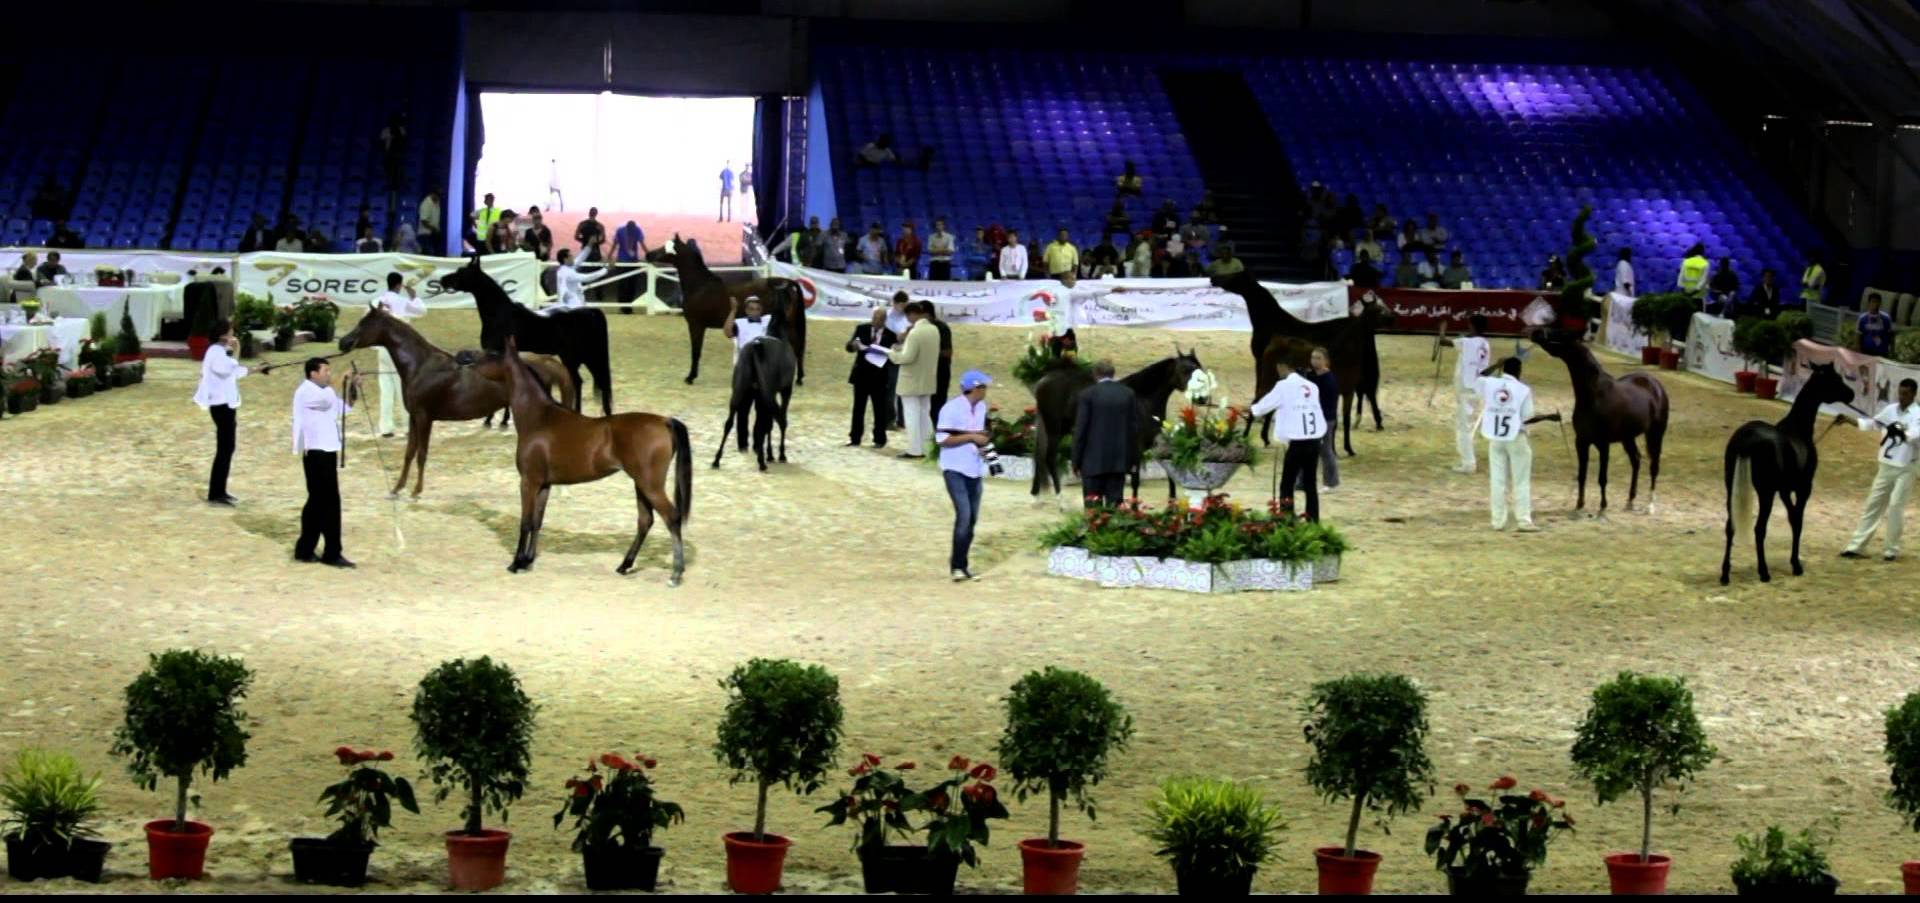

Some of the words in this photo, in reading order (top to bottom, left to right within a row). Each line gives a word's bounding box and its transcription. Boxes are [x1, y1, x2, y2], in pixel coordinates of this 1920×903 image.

[285, 278, 379, 294] SOREC
[1452, 309, 1480, 321] مبي
[1302, 411, 1317, 436] 13
[1493, 414, 1511, 437] 15
